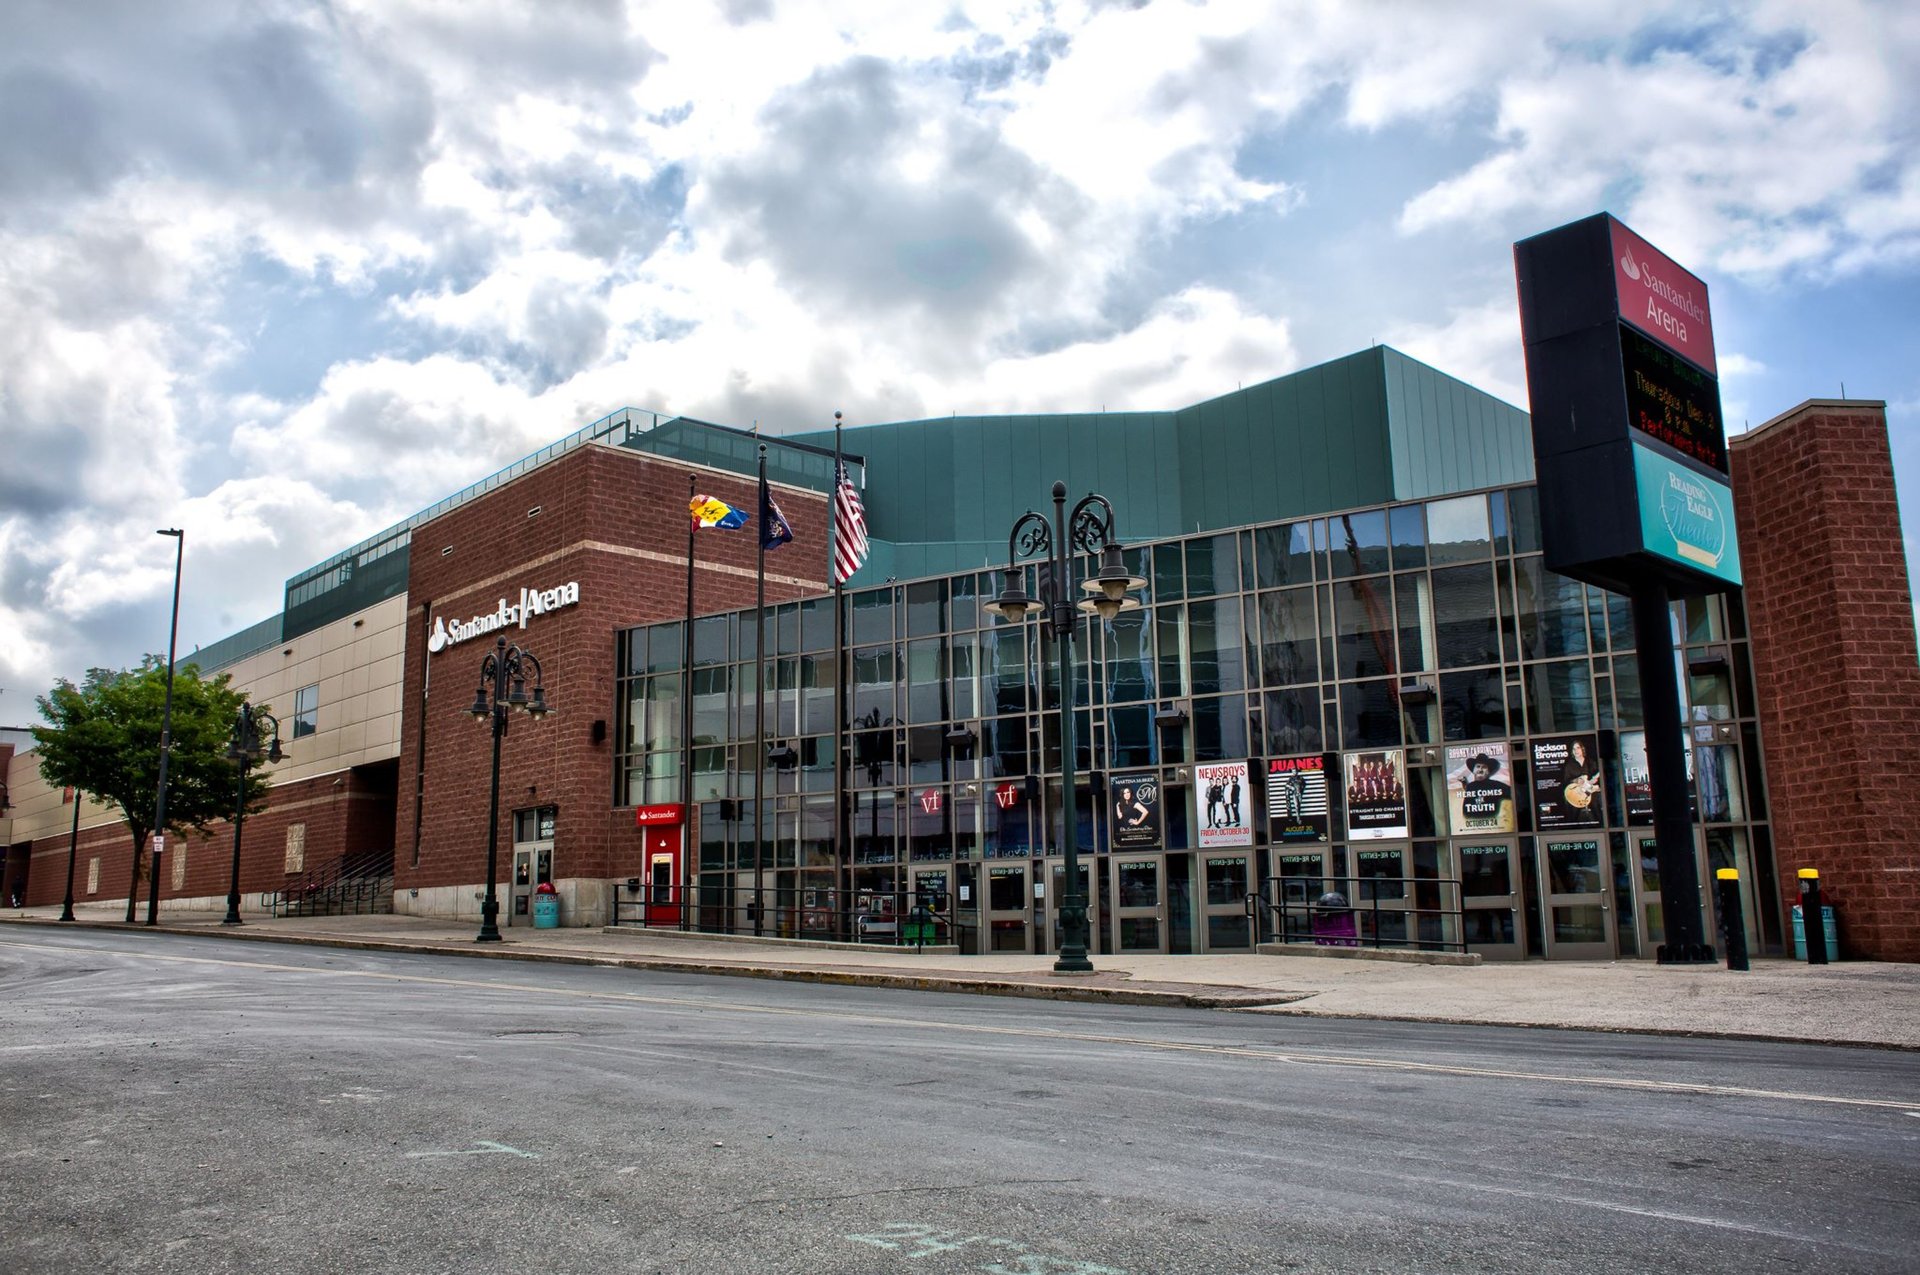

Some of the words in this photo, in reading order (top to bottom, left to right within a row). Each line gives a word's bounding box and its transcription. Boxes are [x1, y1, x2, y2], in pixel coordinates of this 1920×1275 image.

[1641, 262, 1705, 325] Santander
[1647, 295, 1687, 343] Arena
[1668, 471, 1707, 503] READING
[1686, 495, 1715, 522] EAGLE
[447, 599, 520, 646] Santander
[526, 582, 580, 618] Arena
[1534, 743, 1567, 753] Jackson
[1535, 751, 1569, 760] Browne
[1198, 765, 1245, 779] NEWSBOYS
[1270, 756, 1323, 773] JUANES
[996, 784, 1015, 808] vf
[1456, 790, 1476, 798] HERE
[1477, 788, 1503, 797] COMES
[921, 790, 940, 813] vf
[1465, 803, 1495, 812] TRUTH
[648, 810, 675, 819] Santander
[1465, 819, 1490, 828] OCTOBER
[1490, 818, 1498, 827] 24
[1200, 829, 1219, 837] FRIDAY,
[1219, 828, 1241, 836] OCTOBER
[1242, 827, 1249, 835] 30
